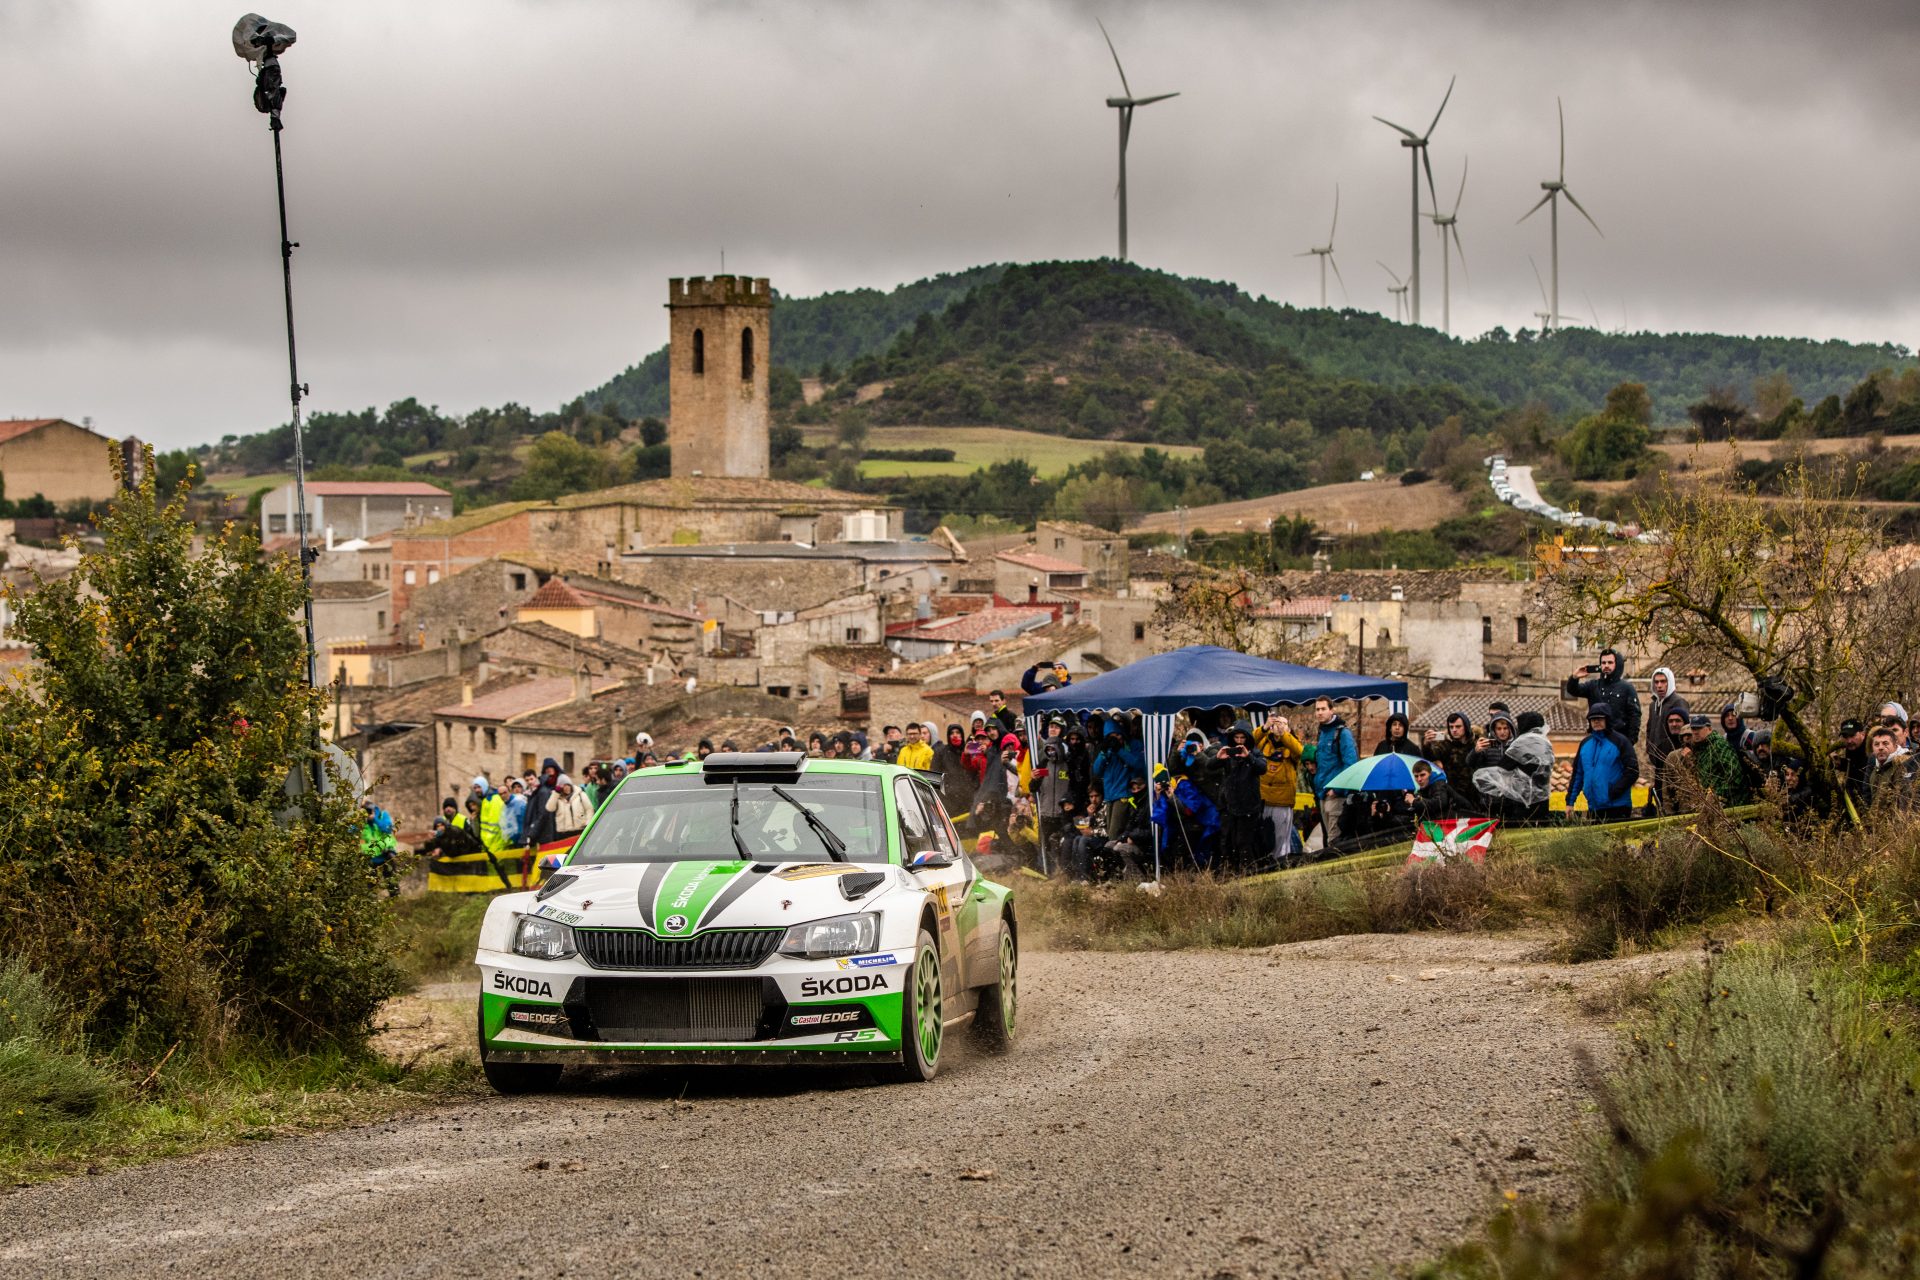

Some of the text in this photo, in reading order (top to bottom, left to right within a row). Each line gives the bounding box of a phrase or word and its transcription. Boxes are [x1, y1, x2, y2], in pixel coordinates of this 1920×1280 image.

[858, 956, 895, 965] MICHELIN
[494, 970, 553, 998] ŠKODA
[801, 974, 888, 997] ŠKODA
[529, 1013, 557, 1024] EDGE
[798, 1011, 861, 1024] Castrol EDGE
[834, 1030, 878, 1042] R5
